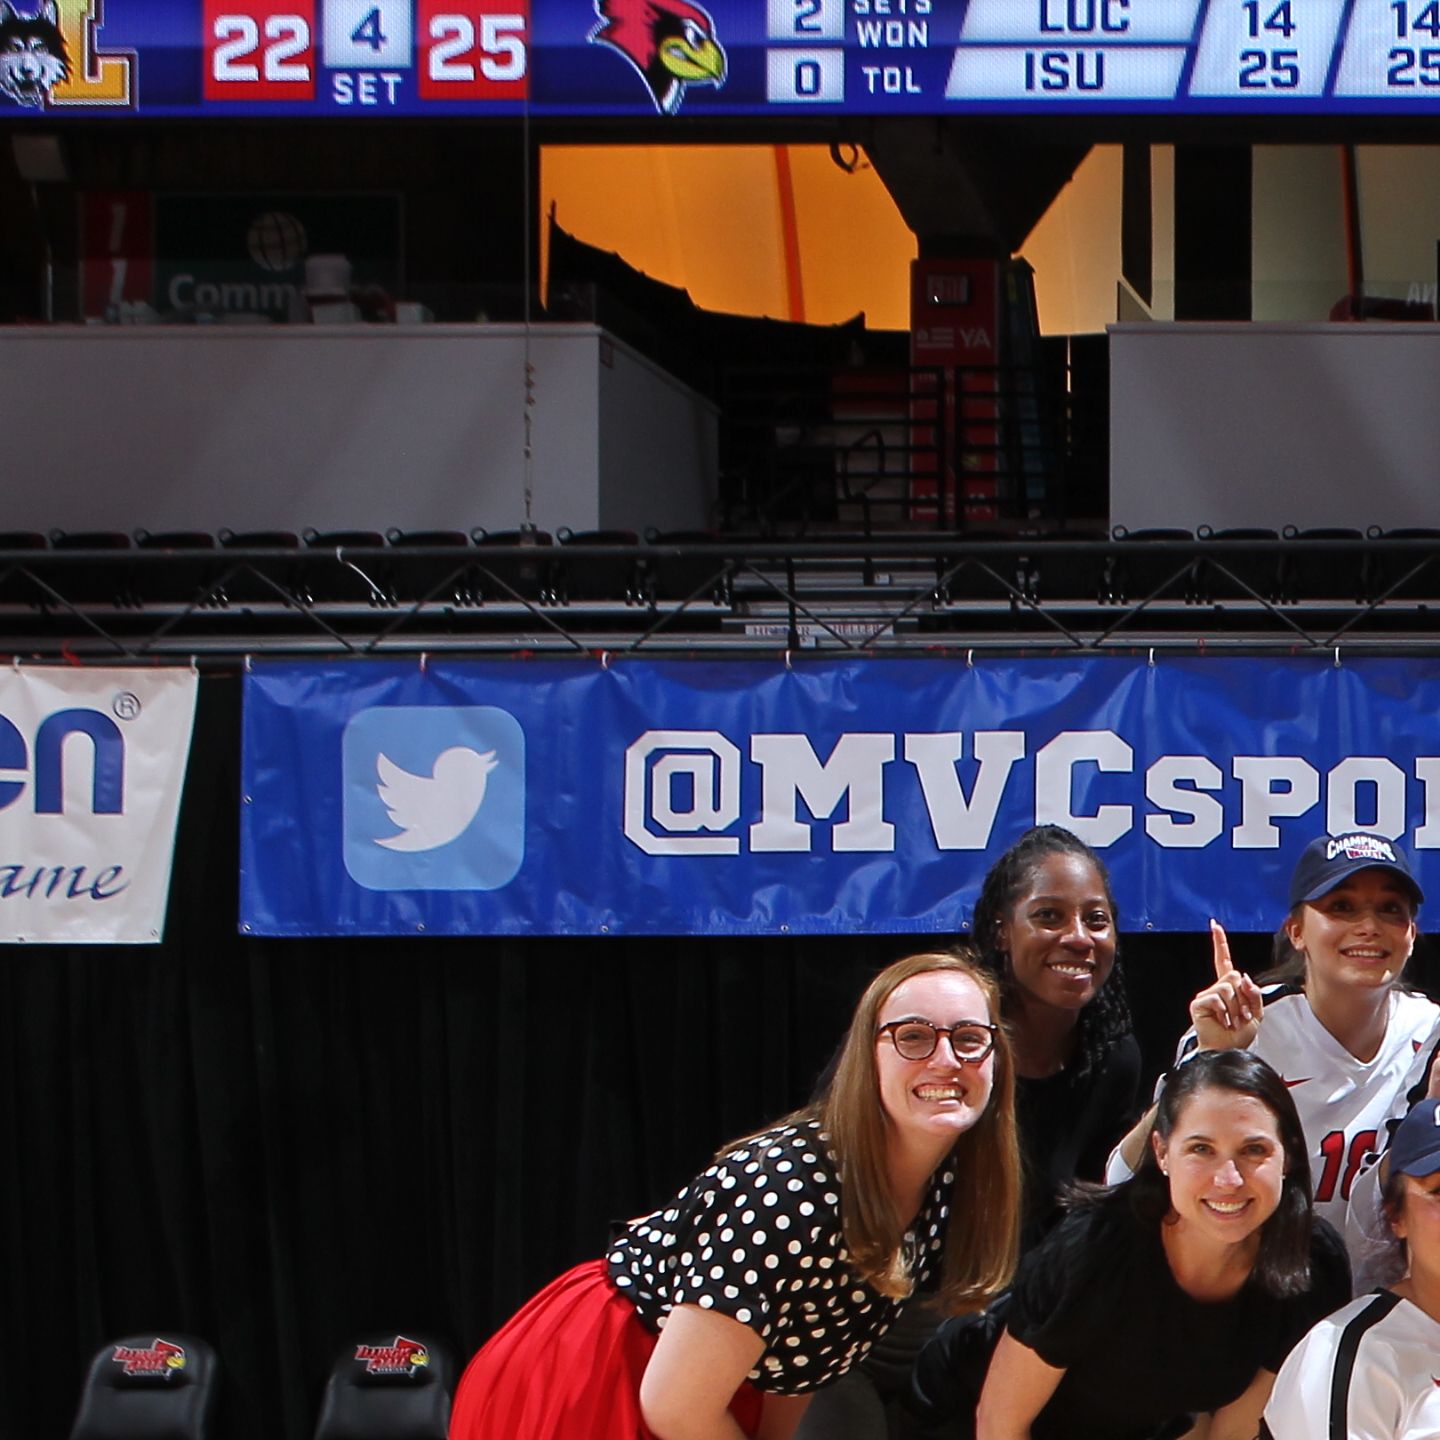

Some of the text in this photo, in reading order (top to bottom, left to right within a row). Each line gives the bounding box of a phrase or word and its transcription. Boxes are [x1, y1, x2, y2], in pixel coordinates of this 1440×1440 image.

[351, 7, 387, 54] 4
[795, 0, 822, 33] 2
[856, 20, 929, 48] WON
[1040, 0, 1129, 32] LUC
[1241, 0, 1296, 39] 14
[213, 14, 311, 82] 22
[428, 13, 528, 82] 25
[795, 57, 822, 95] 0
[861, 65, 923, 95] TOL
[1024, 51, 1105, 91] ISU
[1238, 48, 1301, 89] 25
[332, 72, 402, 106] SET
[1327, 835, 1396, 862] CHAMPIONS
